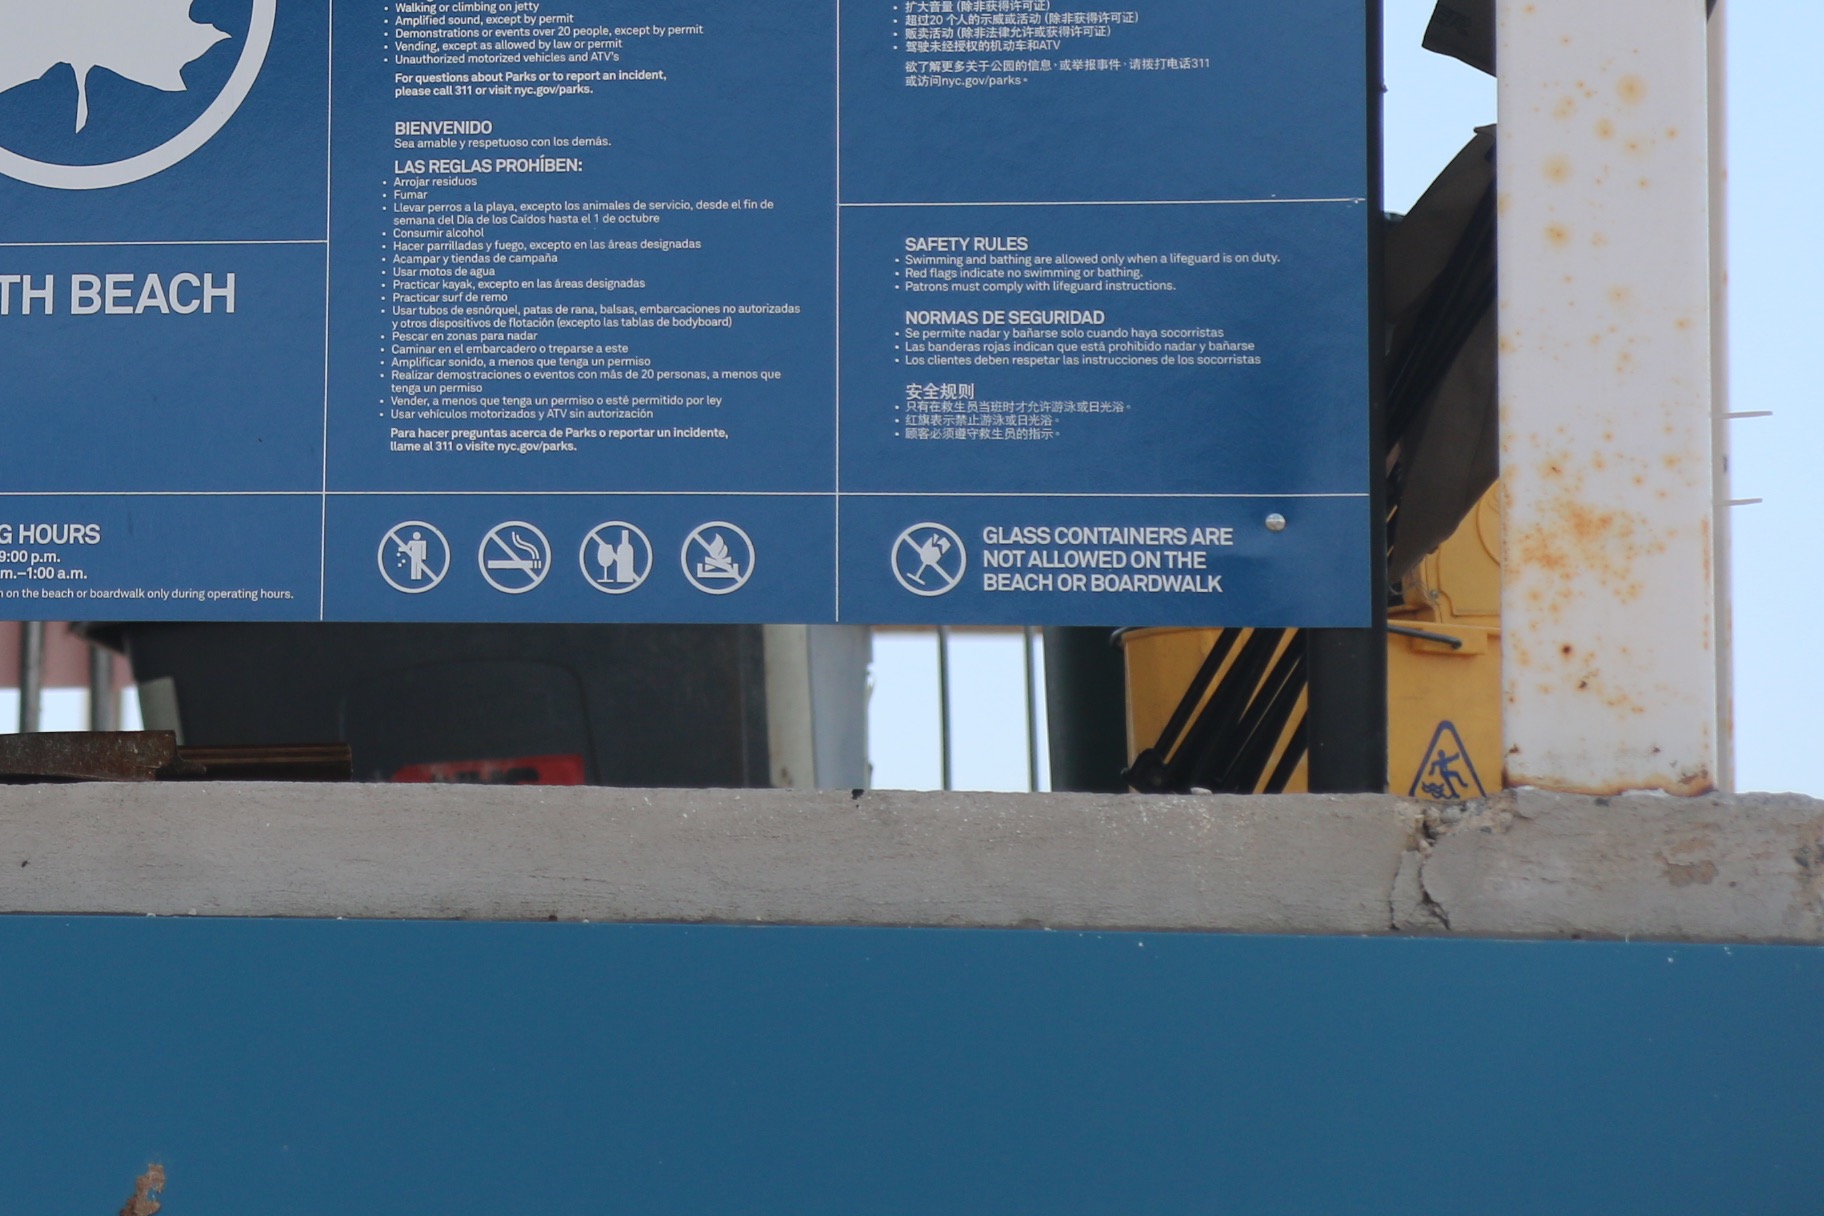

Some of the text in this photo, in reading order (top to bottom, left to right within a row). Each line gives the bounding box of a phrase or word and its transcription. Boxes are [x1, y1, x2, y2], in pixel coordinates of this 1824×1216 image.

[394, 82, 593, 98] please call 311 or visit nyc.gov/parks.
[394, 120, 492, 134] BIENVENIDO
[393, 135, 611, 150] Sea amable y respetuoso con los demás.
[394, 154, 582, 173] LAS REGLAS PROHÍBEN:
[393, 175, 477, 188] Arrojar residuos
[393, 188, 428, 199] Fumar
[904, 236, 1028, 251] SAFETY RULES
[904, 251, 1280, 267] Swimming and bathing are allowed only when a lifeguard is on duty.
[904, 265, 1143, 280] Red flags indicate no swimming or bathing.
[70, 272, 235, 314] BEACH
[904, 278, 1176, 293] Patrons must comply with lifeguard instructions.
[904, 310, 1105, 324] NORMAS DE SEGURIDAD
[905, 383, 975, 400] 安全规则
[389, 439, 577, 453] llame al 311 o visite nyc.gov/parks.
[18, 523, 100, 543] HOURS
[982, 526, 1233, 544] GLASS CONTAINERS ARE
[30, 551, 60, 565] p.m.
[982, 549, 1207, 568] NOT ALLOWED ON THE
[56, 568, 87, 579] a.m.
[982, 573, 1222, 592] BEACH OR BOARDWALK
[5, 589, 19, 598] on
[21, 586, 39, 598] the
[41, 586, 74, 598] beach
[75, 589, 87, 598] or
[89, 586, 145, 598] boardwalk
[146, 587, 169, 600] only
[170, 587, 205, 601] during
[206, 587, 258, 601] operating
[260, 587, 293, 598] hours.
